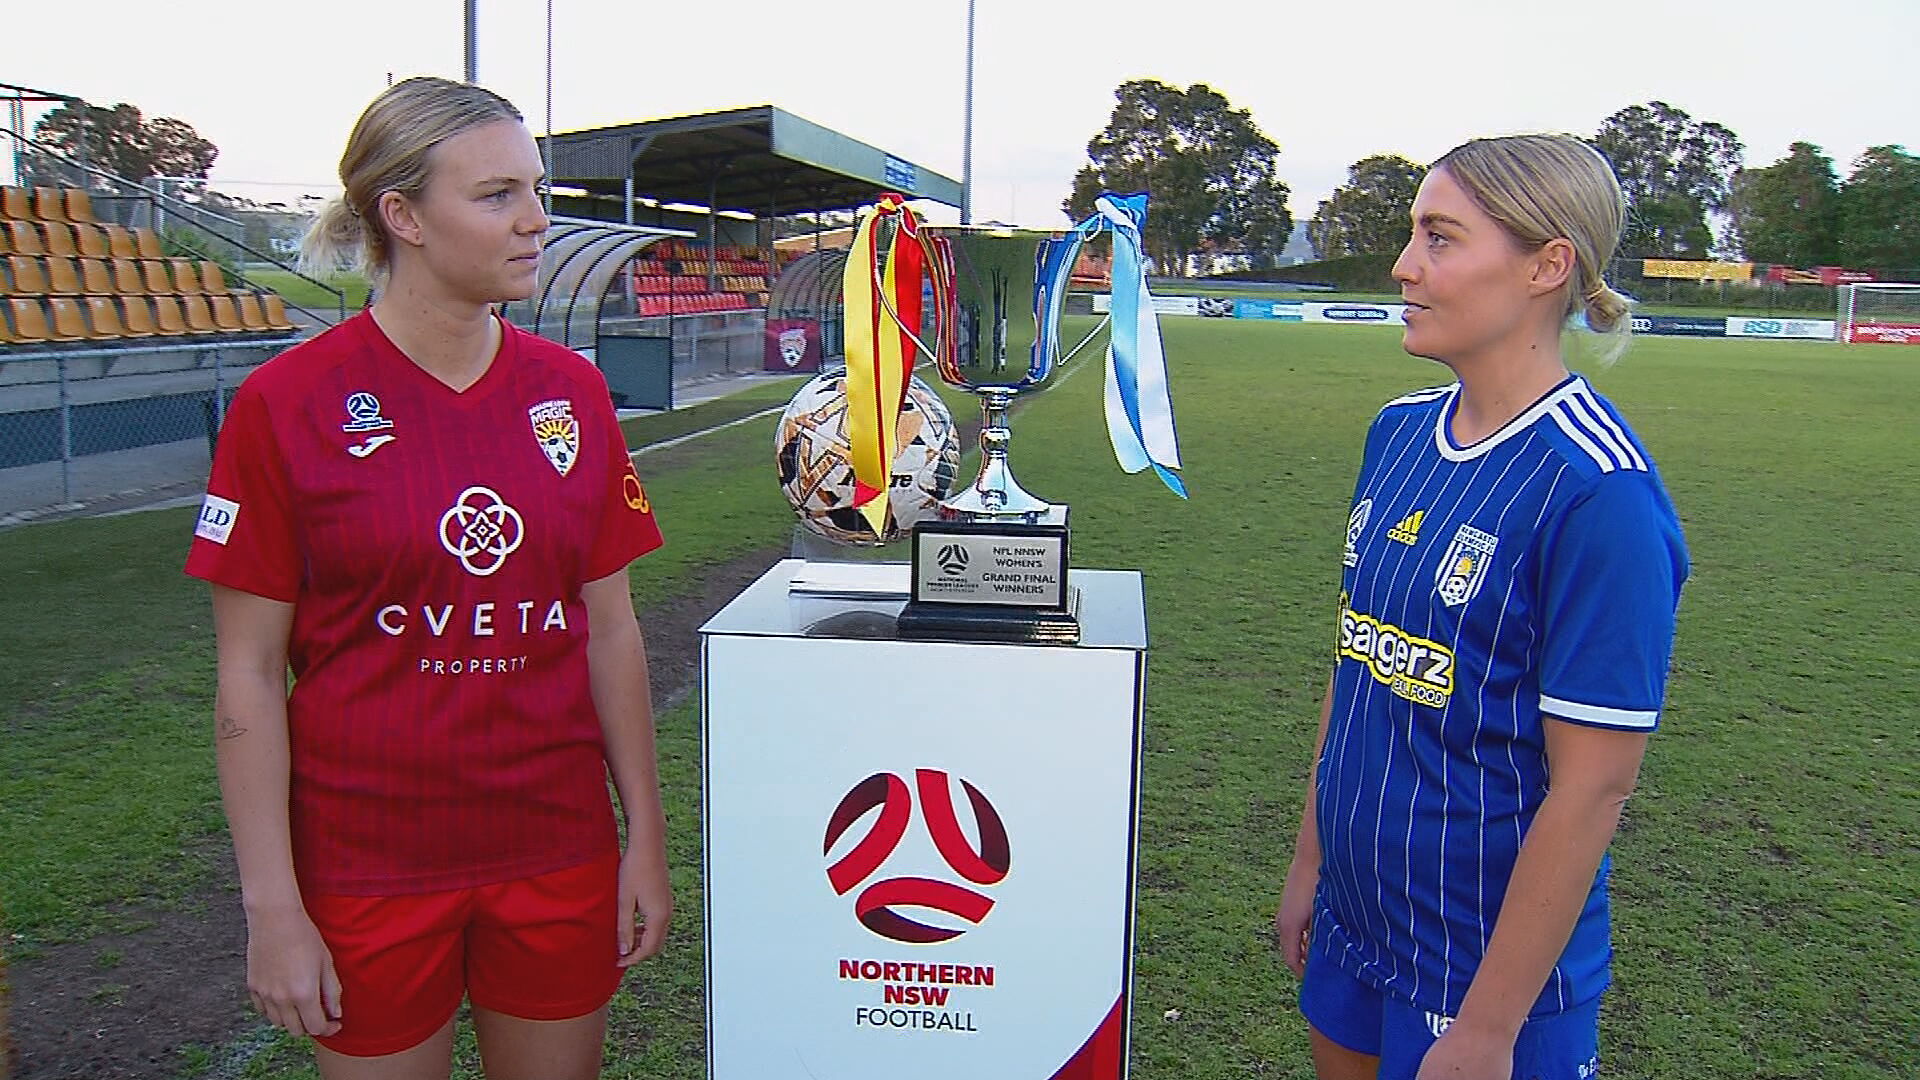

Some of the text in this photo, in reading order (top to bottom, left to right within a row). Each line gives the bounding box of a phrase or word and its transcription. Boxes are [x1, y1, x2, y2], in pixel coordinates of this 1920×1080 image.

[531, 406, 573, 426] MAGIC
[1387, 528, 1418, 546] adidas
[1014, 547, 1046, 557] NNSW
[995, 558, 1043, 568] WOMEN'S
[982, 572, 1057, 585] GRAND FINAL
[993, 584, 1044, 594] WINNERS
[421, 656, 527, 675] PROPERTY
[1410, 683, 1445, 705] FOOD
[839, 959, 995, 986] NORTHERN
[884, 985, 950, 1006] NSW
[856, 1008, 977, 1032] FOOTBALL
